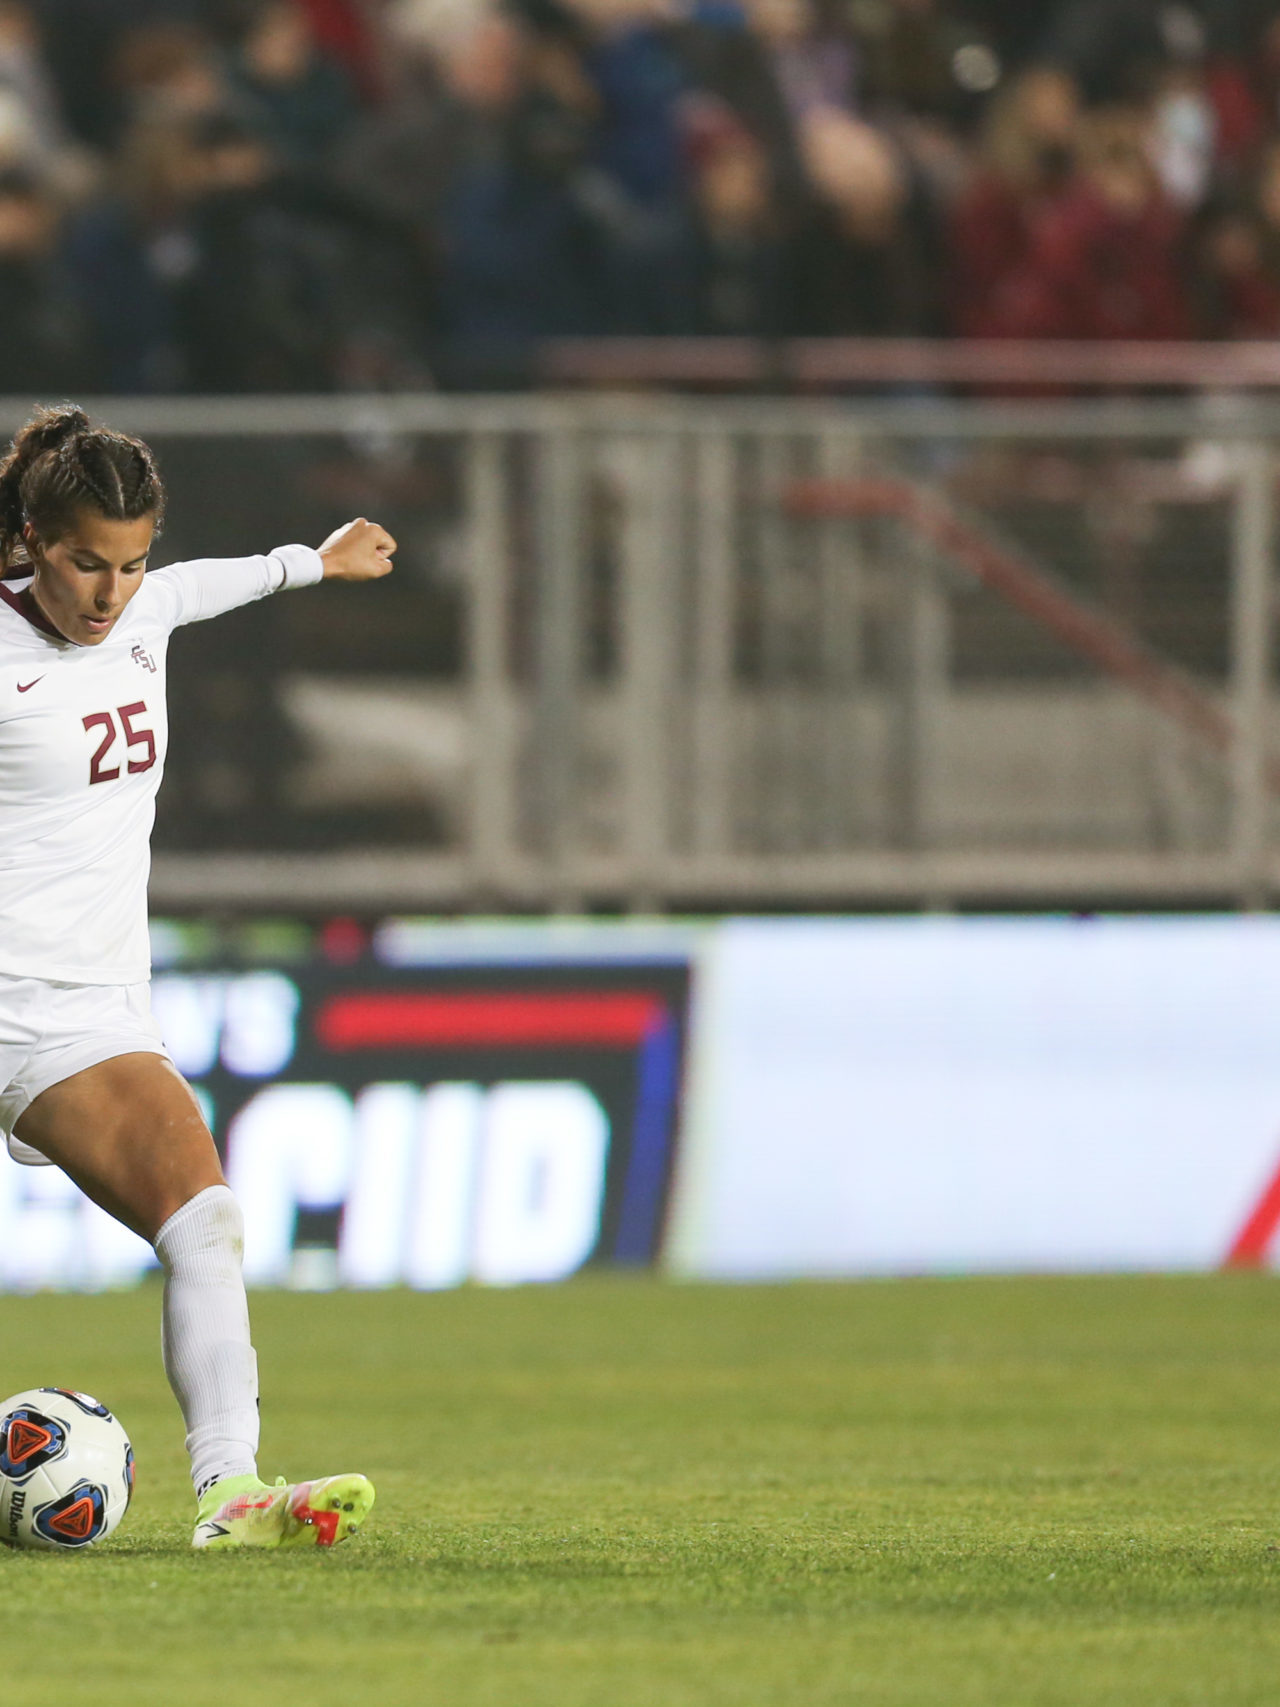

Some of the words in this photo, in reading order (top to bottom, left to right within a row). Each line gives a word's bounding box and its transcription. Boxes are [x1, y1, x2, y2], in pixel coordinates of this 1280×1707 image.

[131, 644, 158, 674] FSU
[81, 700, 157, 786] 25
[9, 1490, 27, 1538] Wilson
